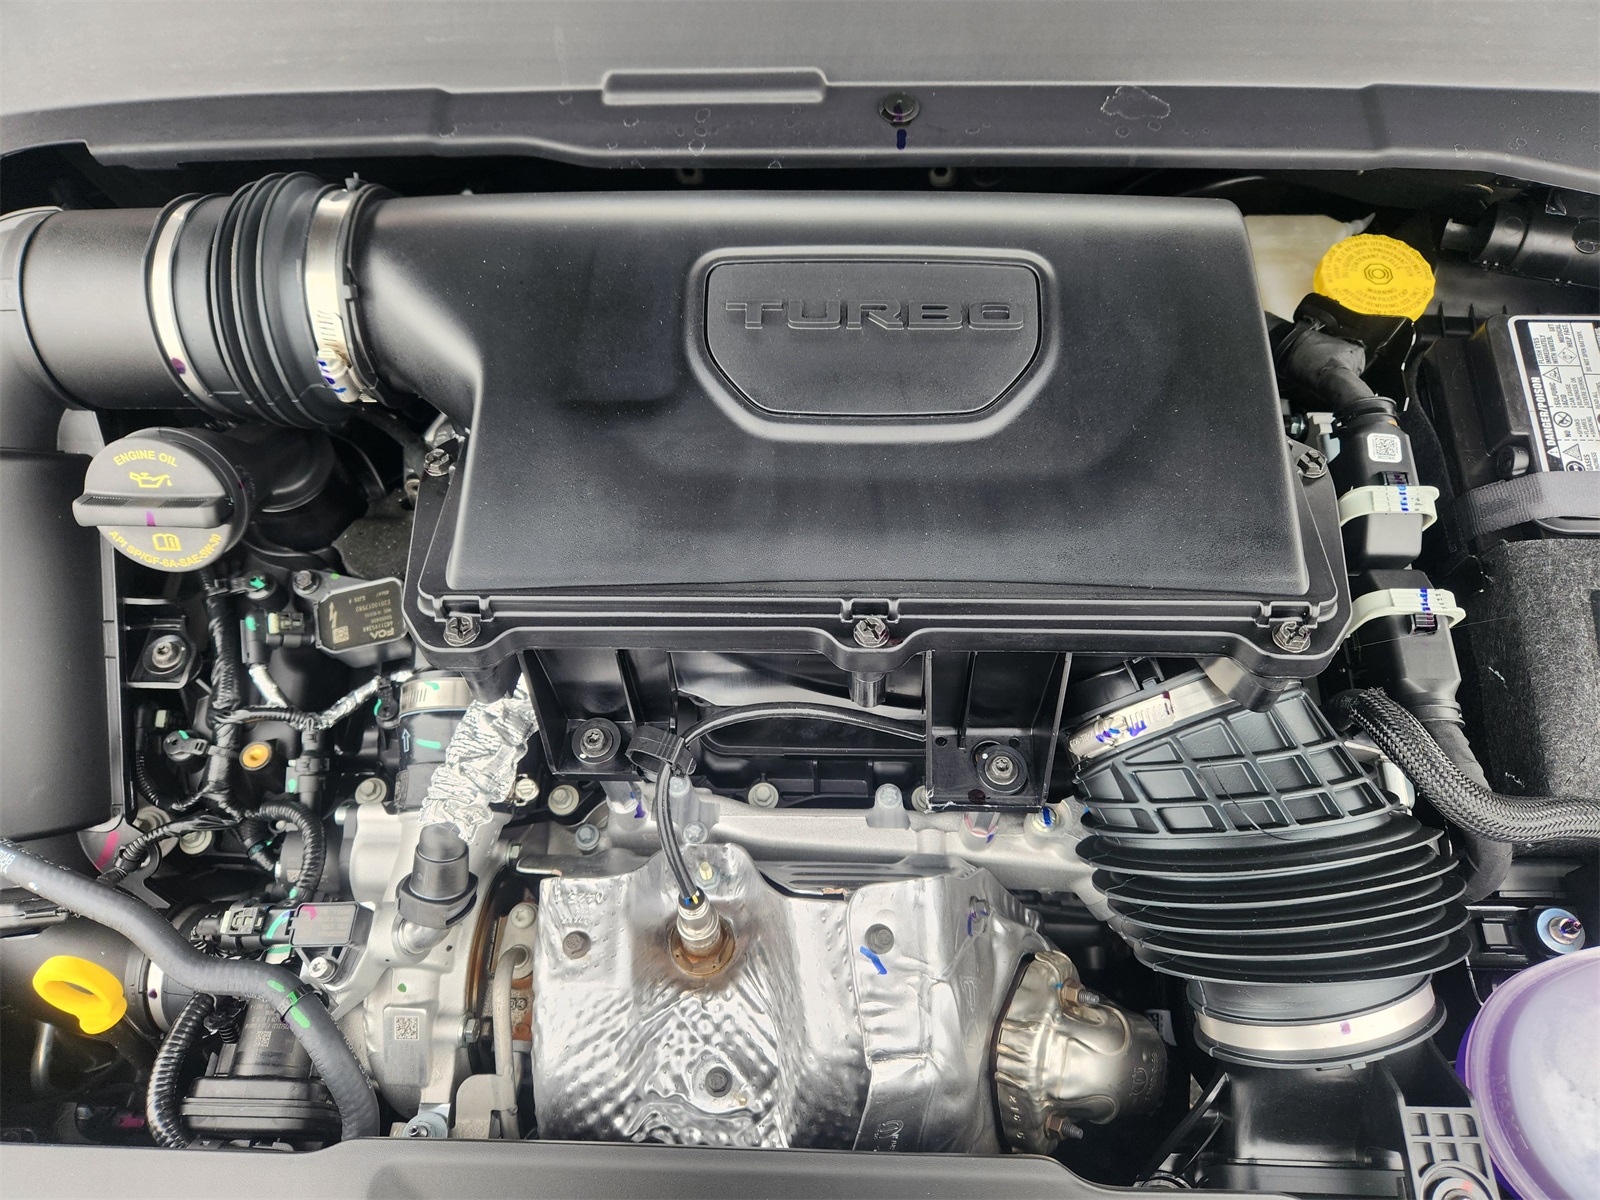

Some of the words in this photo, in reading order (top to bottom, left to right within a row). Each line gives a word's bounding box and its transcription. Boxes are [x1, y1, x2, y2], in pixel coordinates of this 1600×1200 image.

[725, 299, 1024, 331] TURBO
[1531, 376, 1557, 447] DANGER/POISON
[113, 450, 156, 466] ENGINE
[158, 453, 178, 467] OIL
[109, 530, 127, 548] API
[370, 627, 395, 639] FCA
